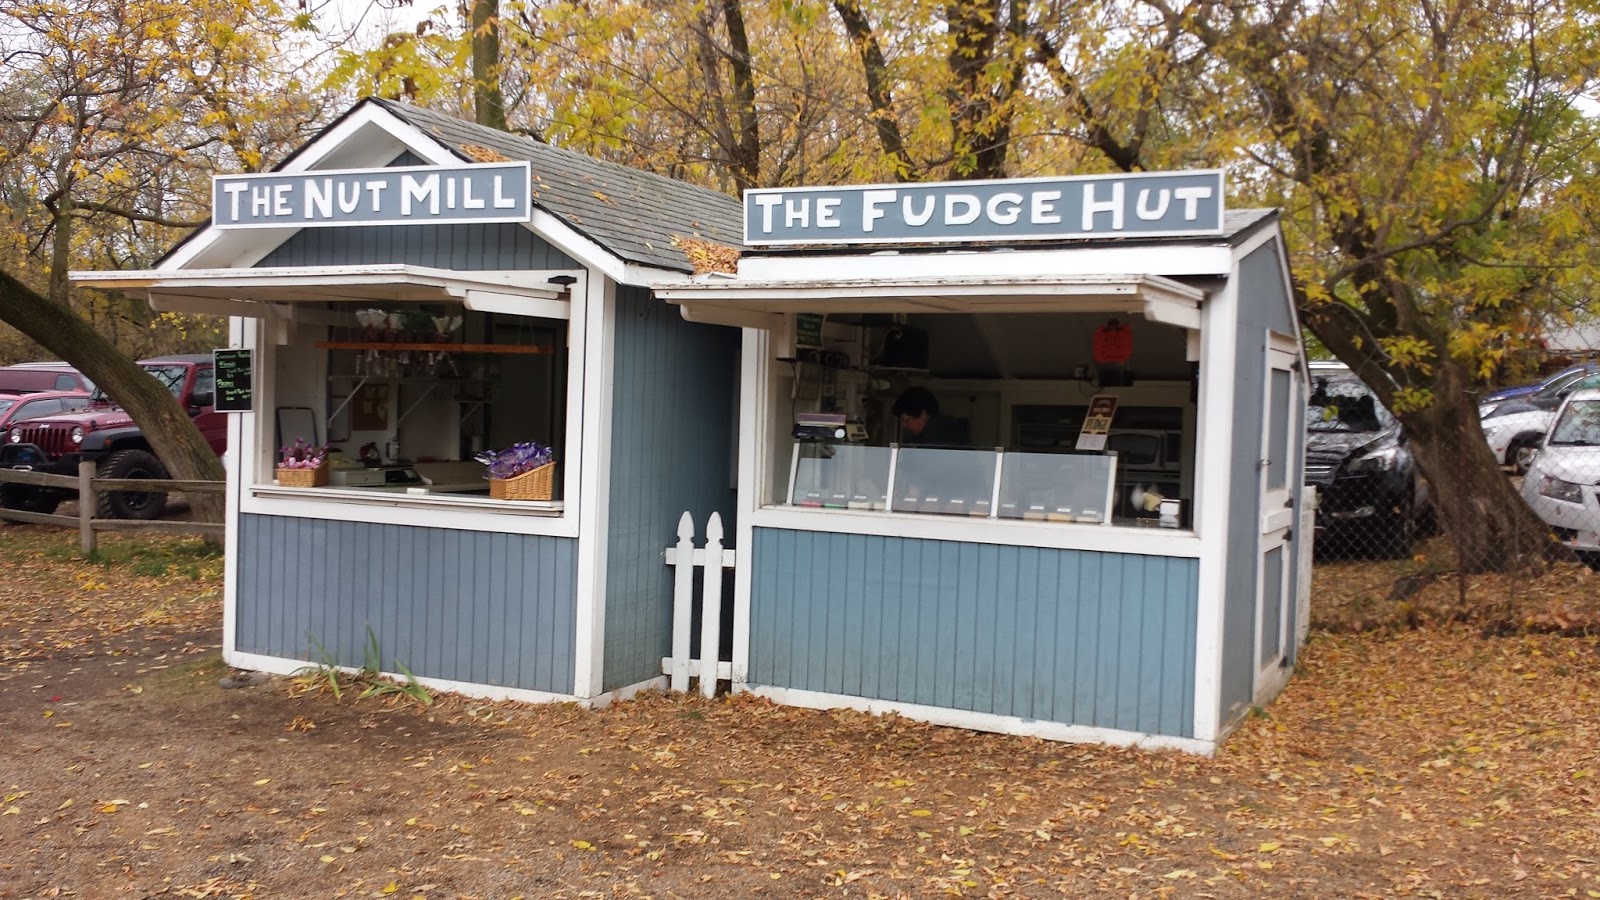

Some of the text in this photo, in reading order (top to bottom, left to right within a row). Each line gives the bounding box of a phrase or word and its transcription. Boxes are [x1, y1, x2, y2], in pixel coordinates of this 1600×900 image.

[223, 173, 516, 221] THE NUT MILL
[755, 181, 1212, 233] THE FUDGE HUT
